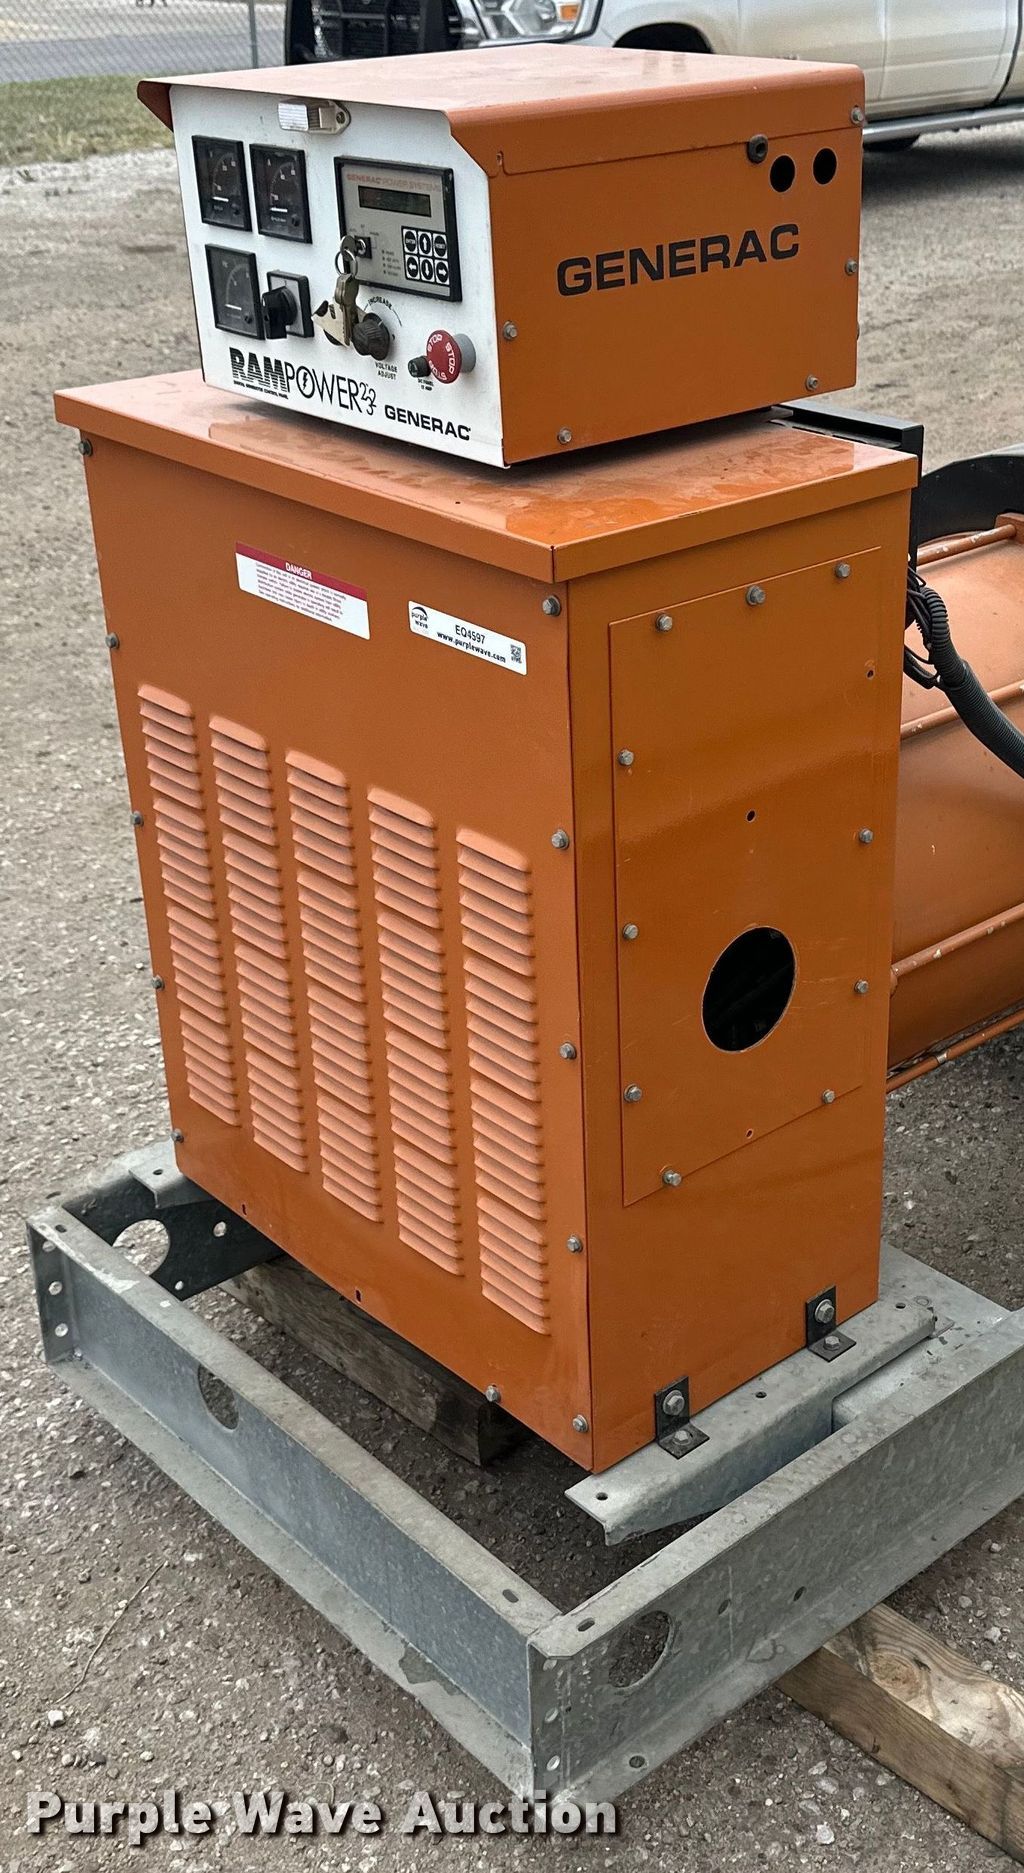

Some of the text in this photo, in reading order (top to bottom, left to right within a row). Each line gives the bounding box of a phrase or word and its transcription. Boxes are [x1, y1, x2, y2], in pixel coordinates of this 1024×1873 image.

[557, 223, 800, 296] GENERAC
[375, 361, 398, 374] VOLTAGE
[377, 370, 397, 381] ADJUST
[384, 404, 471, 441] GENERAC
[285, 561, 313, 580] DANGER
[411, 612, 428, 622] purple
[414, 620, 429, 629] wave
[455, 624, 486, 644] EQ4597
[436, 631, 507, 664] www.purplewave.com
